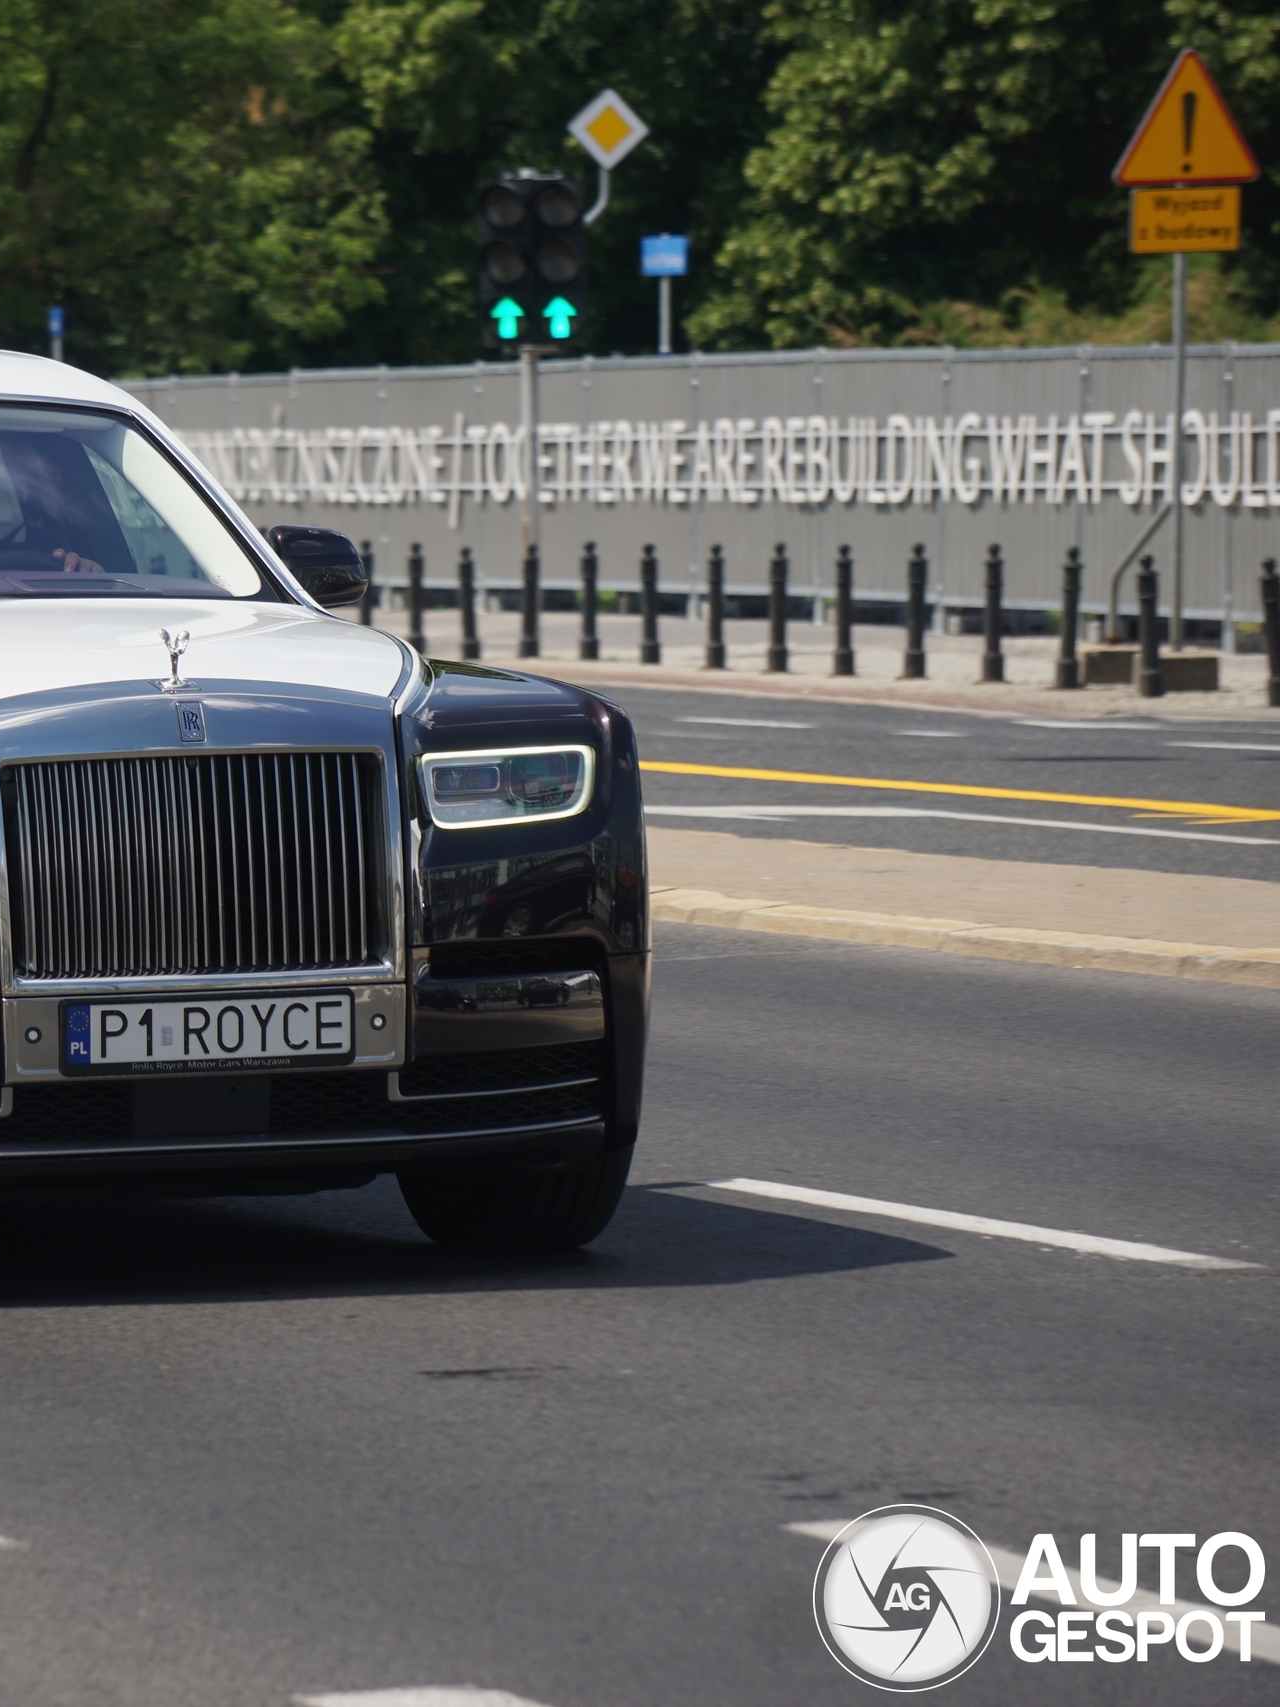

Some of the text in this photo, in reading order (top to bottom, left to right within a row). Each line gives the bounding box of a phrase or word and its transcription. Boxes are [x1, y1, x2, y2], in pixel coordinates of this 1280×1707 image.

[690, 417, 758, 503] ARE
[761, 410, 982, 504] REBUILDING
[986, 411, 1116, 504] WHAT
[100, 1000, 343, 1058] P1 ROYCE
[70, 1041, 88, 1055] PL
[187, 1059, 217, 1069] Motor
[218, 1059, 241, 1068] Cars
[242, 1057, 291, 1067] Warszawa
